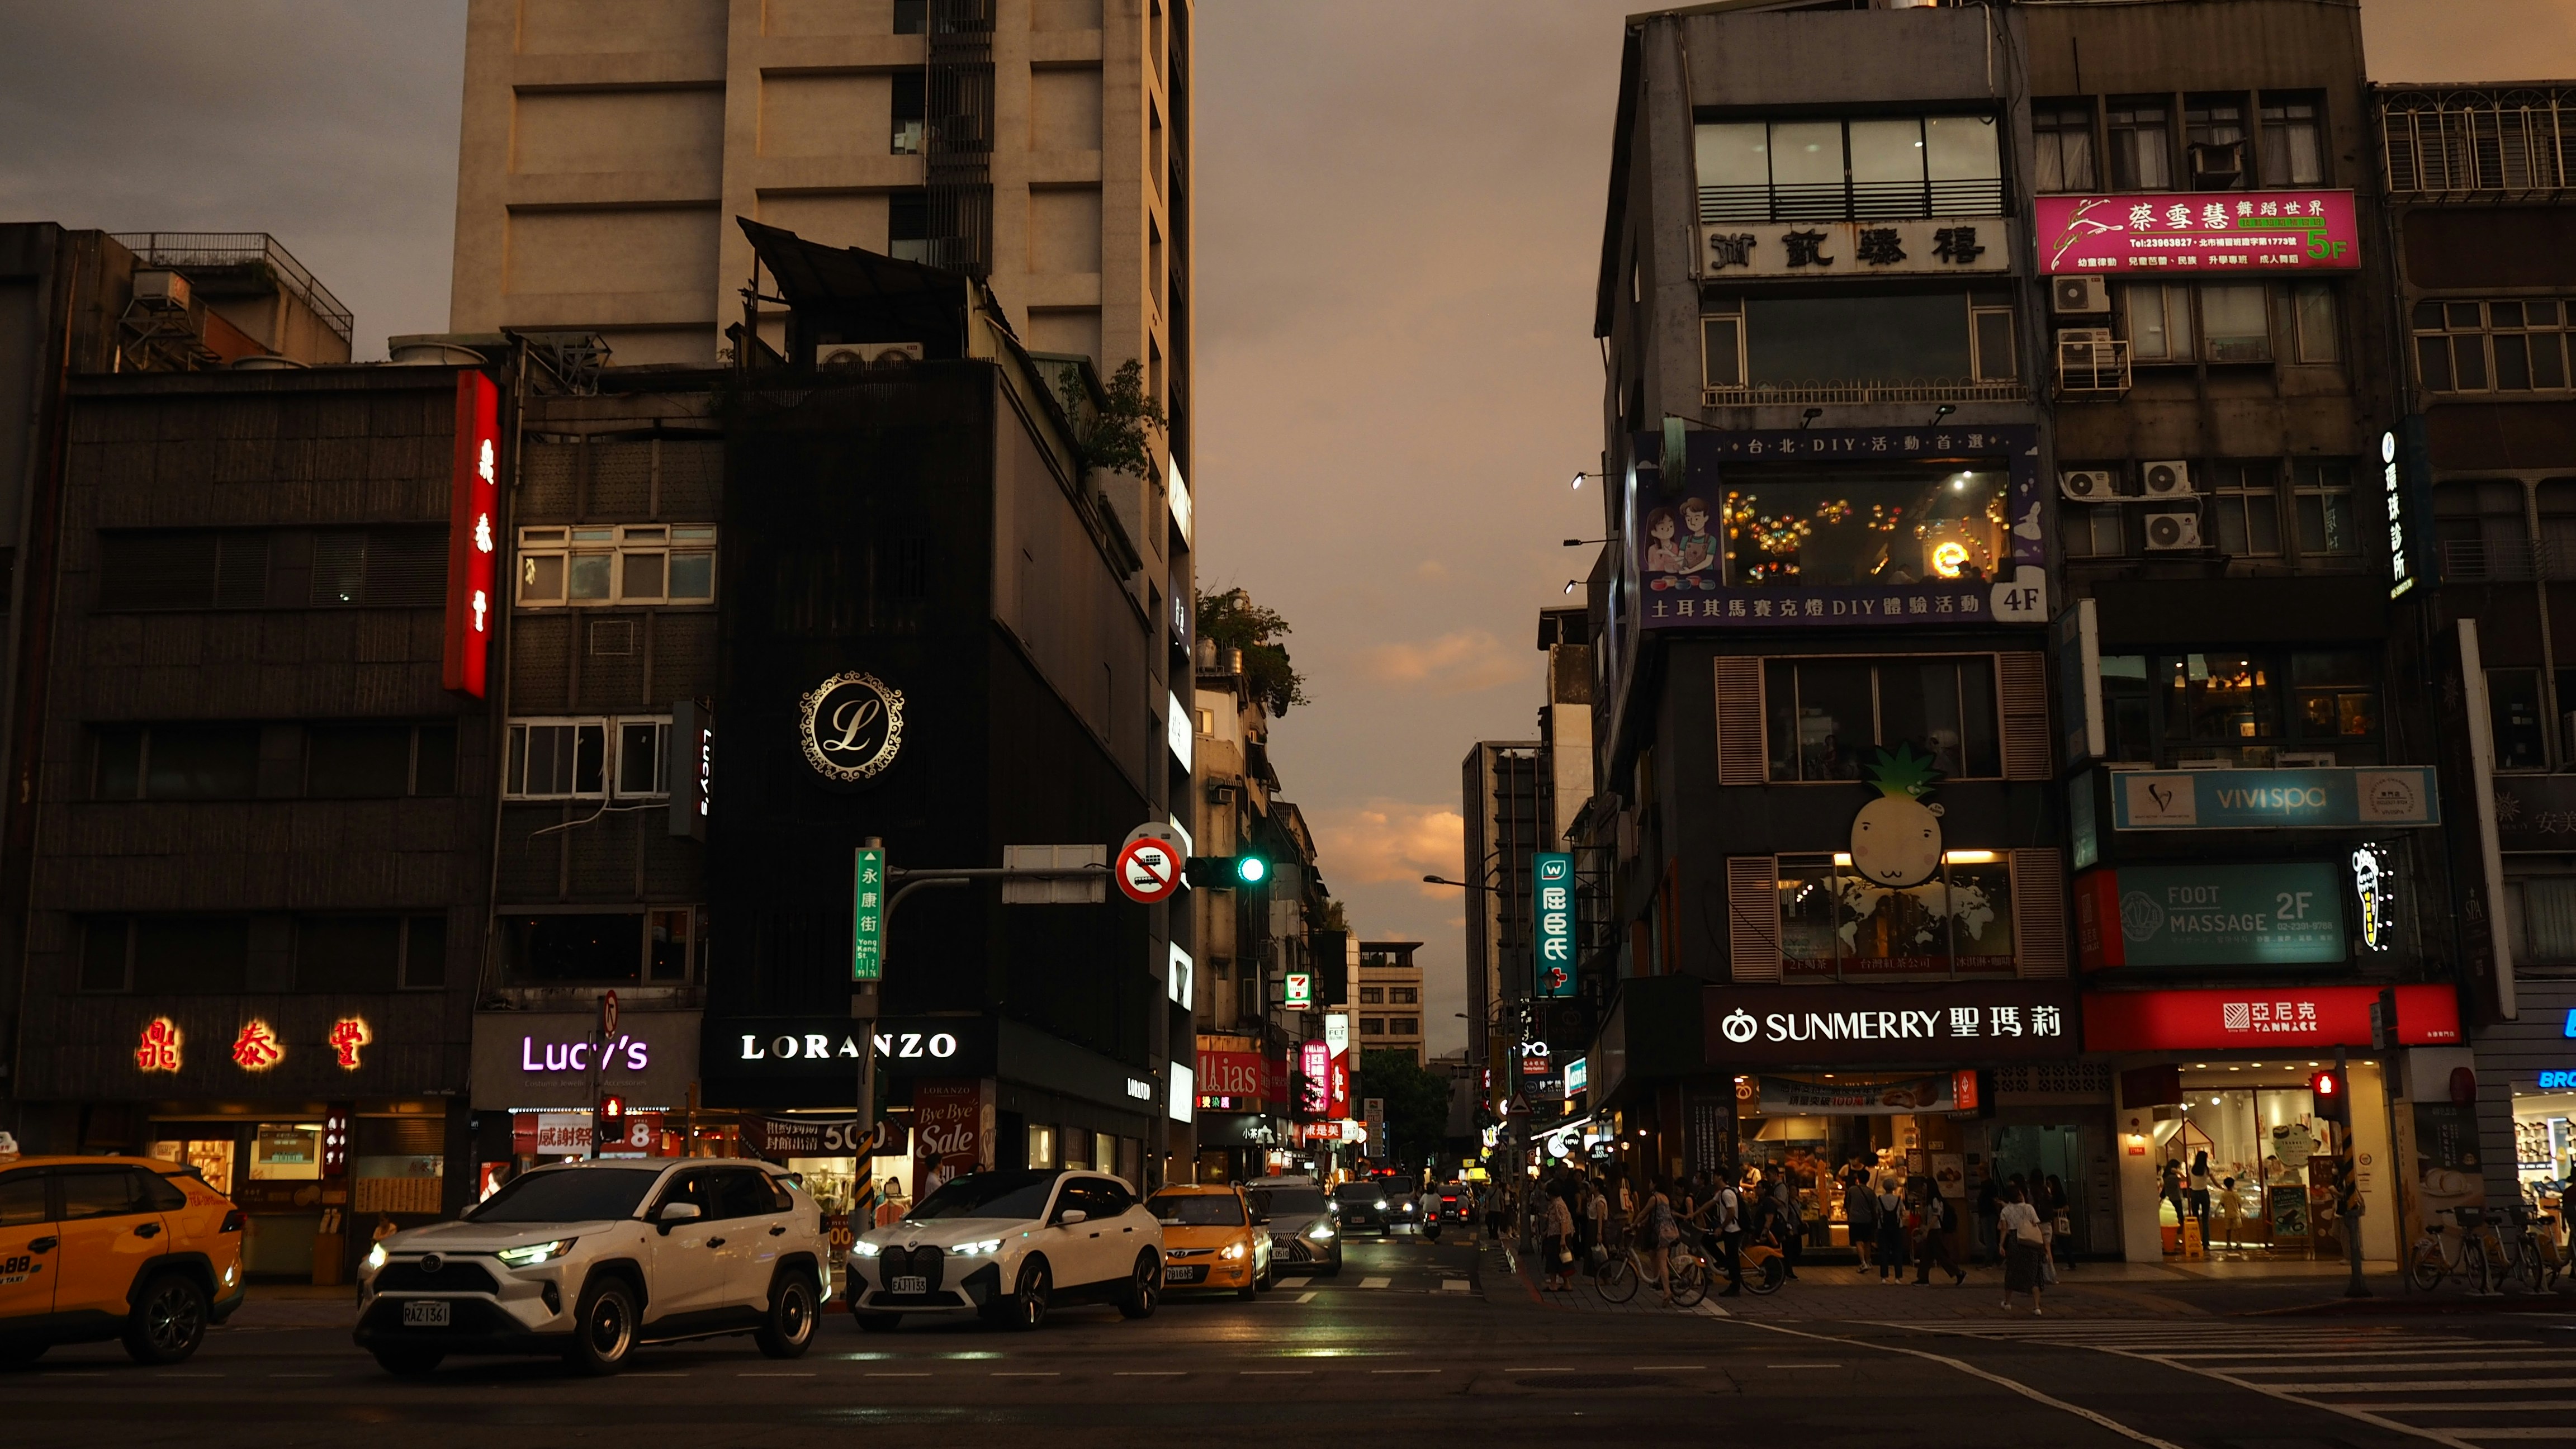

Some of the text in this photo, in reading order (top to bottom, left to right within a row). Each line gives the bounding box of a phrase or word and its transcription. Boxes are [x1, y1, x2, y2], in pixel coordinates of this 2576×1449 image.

[2129, 200, 2324, 231] 蔡雪慧 舞蹈世界
[2307, 229, 2347, 259] 5F
[2385, 462, 2405, 581] 環球診所
[2003, 588, 2038, 612] 4F
[860, 868, 878, 932] 永康街
[2168, 886, 2220, 905] FOOT
[2276, 891, 2313, 920] 2F
[1542, 887, 1568, 960] 屈臣氏
[2170, 913, 2268, 932] MASSAGE
[2465, 899, 2483, 922] SPA
[1765, 1005, 2061, 1042] SUNMERRY 聖瑪莉
[2251, 1001, 2317, 1021] 亞尼克
[136, 1021, 363, 1069] 鼎泰豐
[741, 1033, 957, 1059] LORANZO
[524, 1079, 557, 1088] Costume
[920, 1103, 974, 1124] Bye Bye
[538, 1128, 593, 1147] 感謝祭
[631, 1123, 650, 1148] 8
[916, 1123, 974, 1159] Sale
